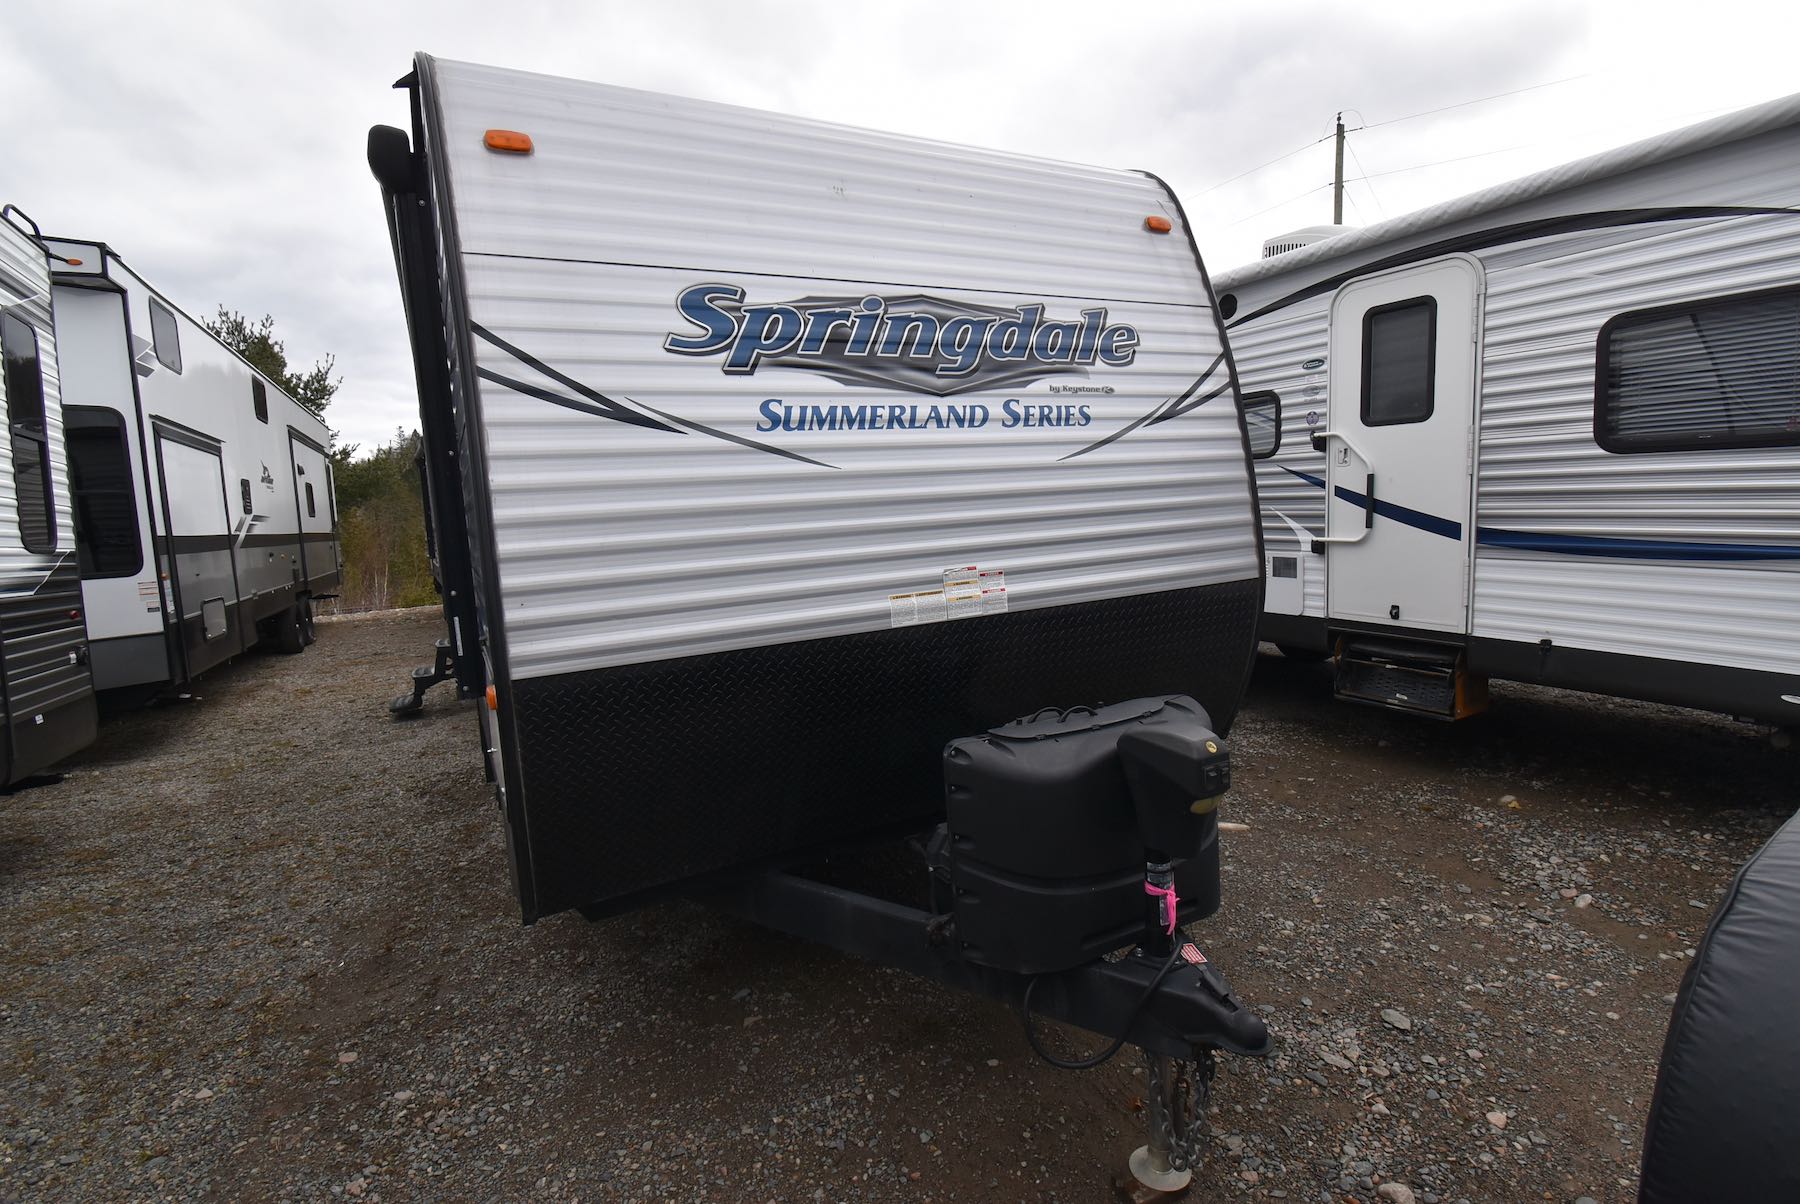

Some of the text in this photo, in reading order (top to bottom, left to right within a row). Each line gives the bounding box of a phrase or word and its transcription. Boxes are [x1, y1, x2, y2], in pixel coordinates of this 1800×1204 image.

[663, 283, 1140, 378] Springdale
[1049, 385, 1100, 394] by Keystone
[756, 398, 1092, 432] SUMMERLAND SERIES
